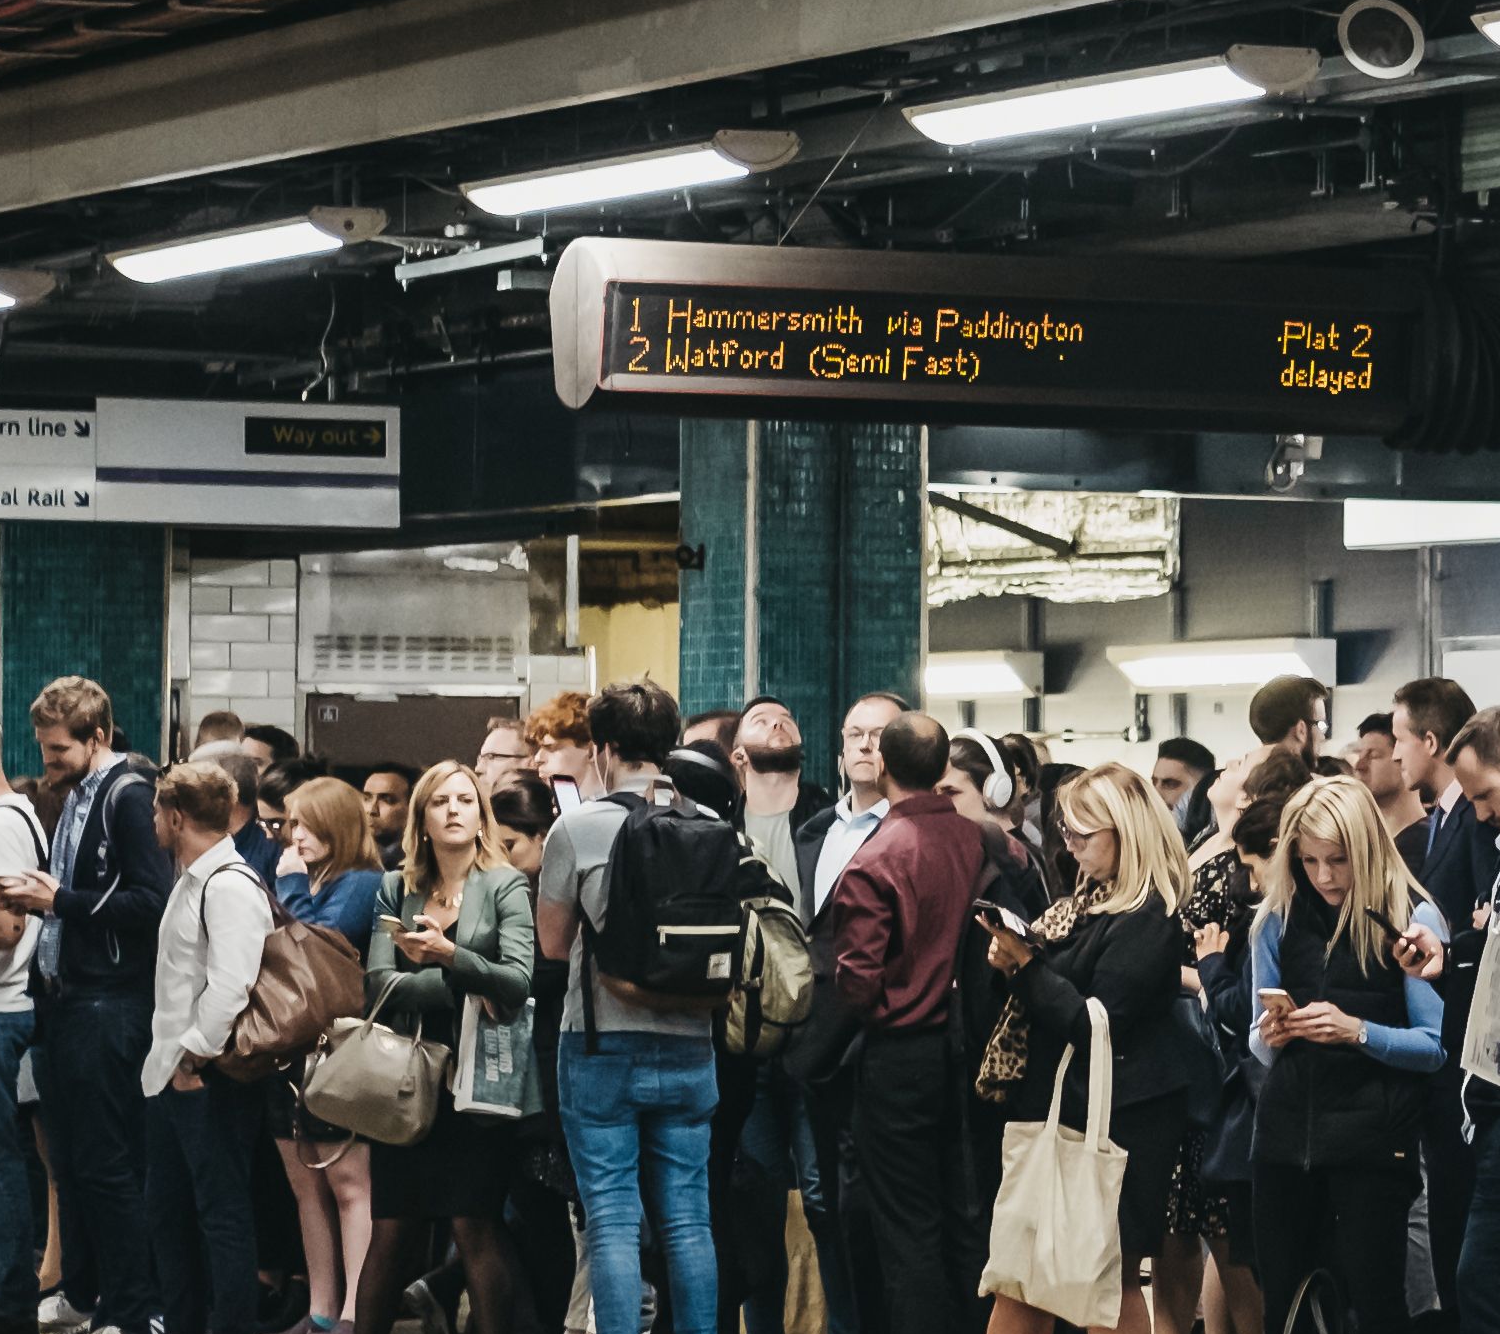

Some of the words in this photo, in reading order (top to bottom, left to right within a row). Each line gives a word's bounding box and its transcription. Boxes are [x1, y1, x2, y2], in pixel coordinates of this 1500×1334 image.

[630, 298, 641, 333] 1
[667, 298, 863, 334] Hammersmith
[887, 310, 922, 337] via
[935, 308, 1083, 350] Paddington
[1282, 320, 1340, 355] Plat
[1351, 323, 1373, 358] 2
[627, 335, 651, 373] 2
[665, 337, 785, 373] Watford
[808, 342, 891, 380] (Semi
[902, 345, 981, 383] Fast)
[1280, 358, 1373, 395] delayed
[28, 416, 68, 438] line
[272, 425, 316, 448] Way
[321, 428, 358, 445] out
[27, 487, 66, 508] Rail
